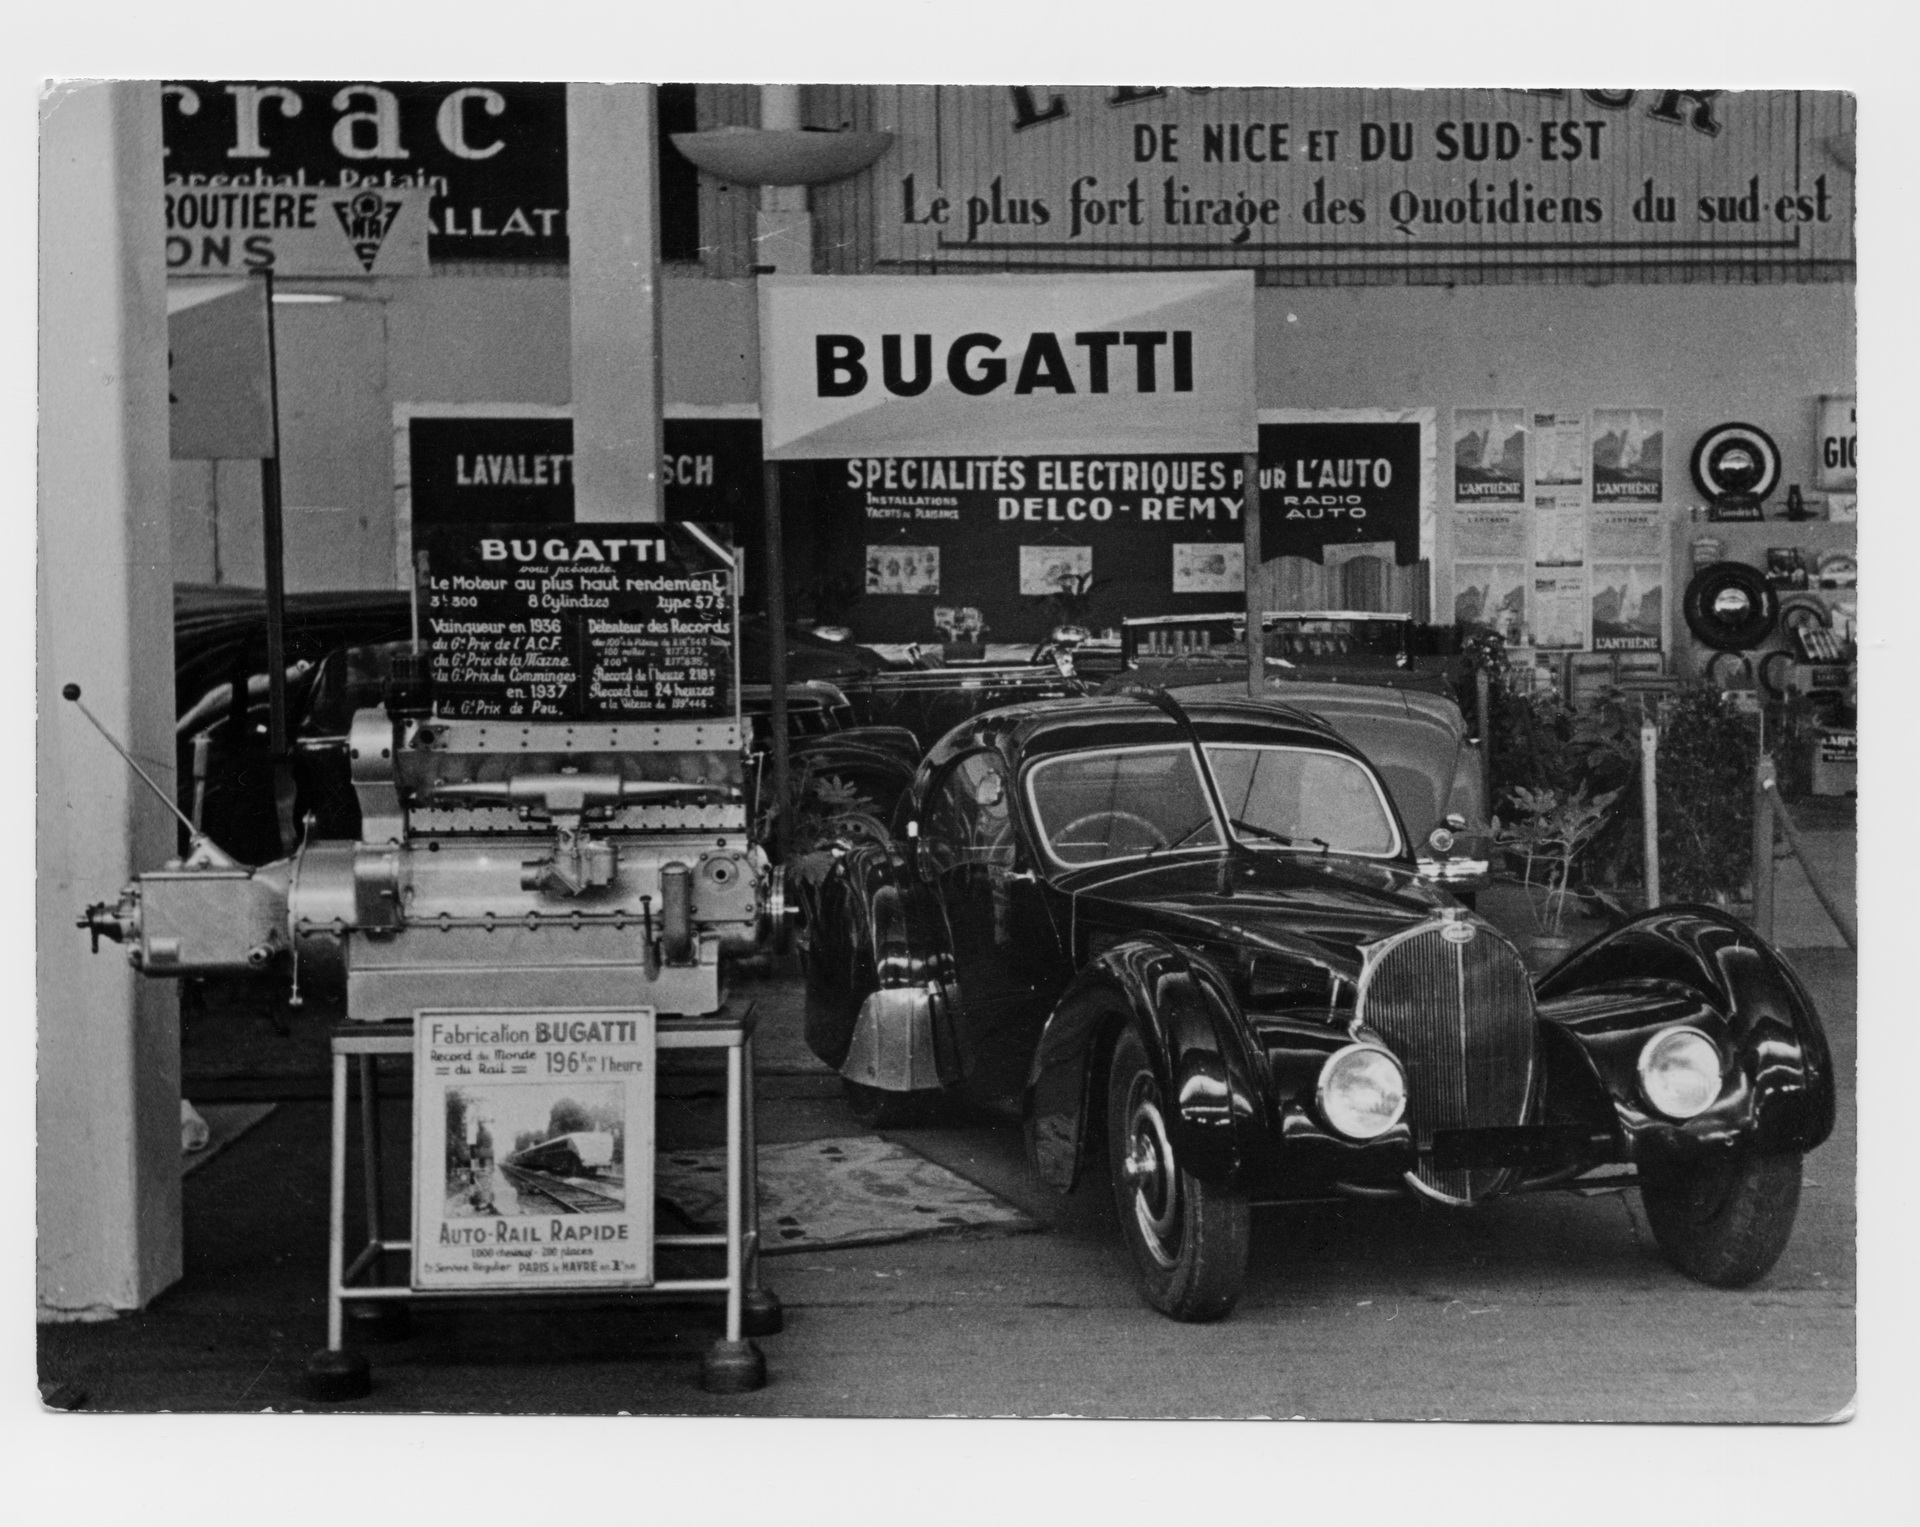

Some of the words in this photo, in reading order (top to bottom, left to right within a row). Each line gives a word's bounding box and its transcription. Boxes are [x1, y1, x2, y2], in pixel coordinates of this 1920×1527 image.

[1133, 122, 1179, 162] DE
[1202, 123, 1289, 162] NICE
[1308, 130, 1339, 161] ET
[1360, 122, 1414, 162] DU
[901, 172, 950, 226] Le
[967, 174, 1051, 242] plus
[1069, 175, 1145, 238] fort
[1163, 174, 1280, 245] tirage
[1302, 175, 1367, 226] des
[1389, 177, 1604, 236] Quotidiens
[1632, 177, 1677, 224] du
[815, 330, 1194, 398] BUGATTI
[1233, 469, 1287, 490] PUR
[1296, 457, 1392, 489] L'AUTO
[999, 496, 1114, 521] DELCO
[1283, 495, 1362, 506] RADIO
[1285, 507, 1367, 519] AUTO
[480, 538, 666, 562] BUGATTI
[519, 565, 549, 574] vous
[430, 576, 450, 590] Le
[452, 576, 508, 590] Moteur
[514, 579, 536, 590] au
[541, 576, 575, 594] plus
[580, 575, 621, 591] haut
[626, 574, 724, 592] rendement
[541, 593, 610, 613] Cylindres
[656, 595, 692, 613] type
[429, 618, 507, 637] Vainqueur
[508, 622, 527, 634] en
[529, 618, 562, 634] 1936
[587, 618, 645, 634] Détenteur
[647, 618, 669, 634] des
[670, 617, 731, 634] Records
[432, 637, 449, 650] du
[467, 636, 492, 651] Prix
[494, 638, 511, 650] de
[433, 653, 450, 667] du
[466, 652, 494, 667] Prix
[493, 653, 509, 667] de
[509, 653, 522, 667] la
[432, 668, 449, 682] du
[464, 667, 490, 682] Prix
[490, 668, 506, 682] du
[509, 666, 577, 687] Comminges
[635, 668, 647, 682] de
[506, 687, 528, 699] en
[530, 684, 568, 699] 1937
[654, 681, 673, 698] 24
[673, 682, 716, 698] heures
[475, 699, 502, 715] Prix
[509, 702, 525, 715] de
[432, 1023, 530, 1045] Fabrication
[535, 1020, 637, 1044] BUGATTI
[430, 1049, 473, 1062] Record
[494, 1049, 537, 1062] Monde
[546, 1051, 580, 1074] 196
[601, 1055, 644, 1073] l'heure
[454, 1063, 472, 1075] du
[479, 1063, 507, 1075] Rail
[438, 1220, 542, 1245] AUTO-RAIL
[550, 1219, 629, 1243] RAPIDE
[518, 1262, 549, 1273] PARIS
[562, 1260, 598, 1272] HAVRE
